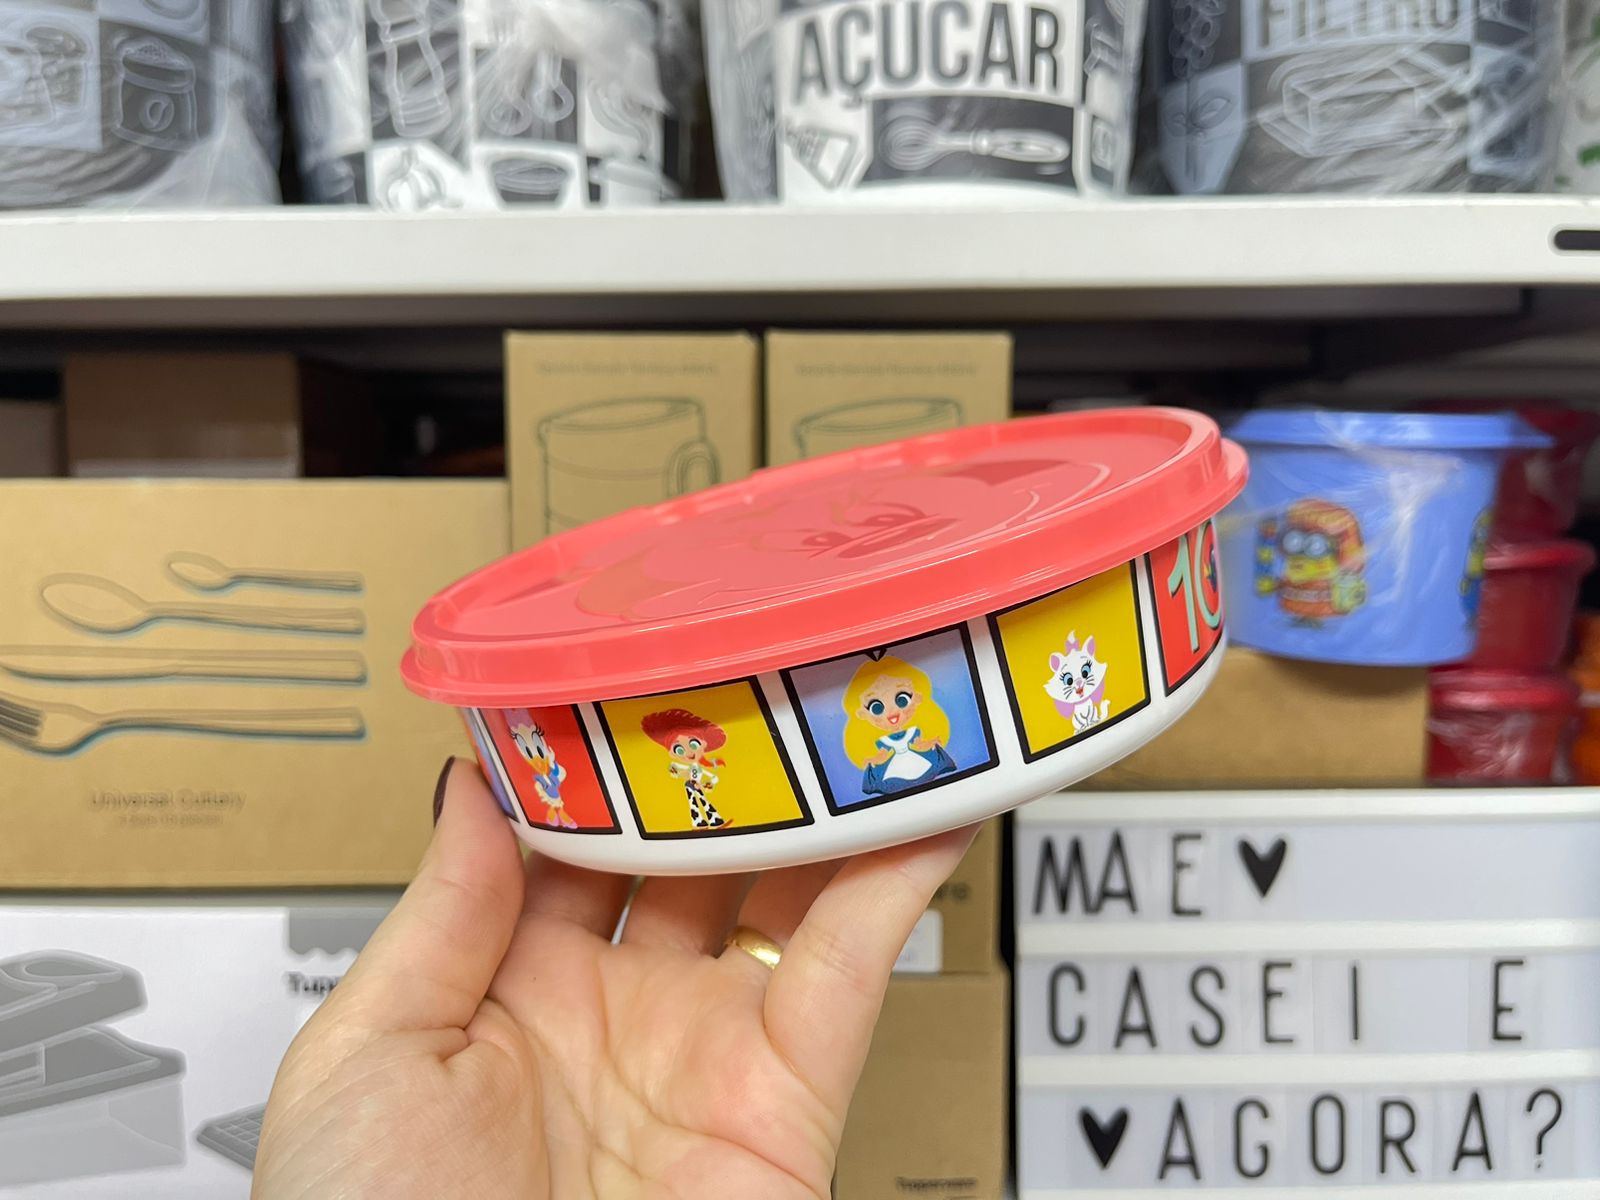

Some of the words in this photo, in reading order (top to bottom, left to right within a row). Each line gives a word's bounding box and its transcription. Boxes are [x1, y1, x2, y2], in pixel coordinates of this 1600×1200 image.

[792, 1, 1062, 107] AÇUCAR
[1049, 961, 1360, 1048] CASEI
[1492, 959, 1524, 1041] E
[1158, 1089, 1563, 1179] AGORA?
